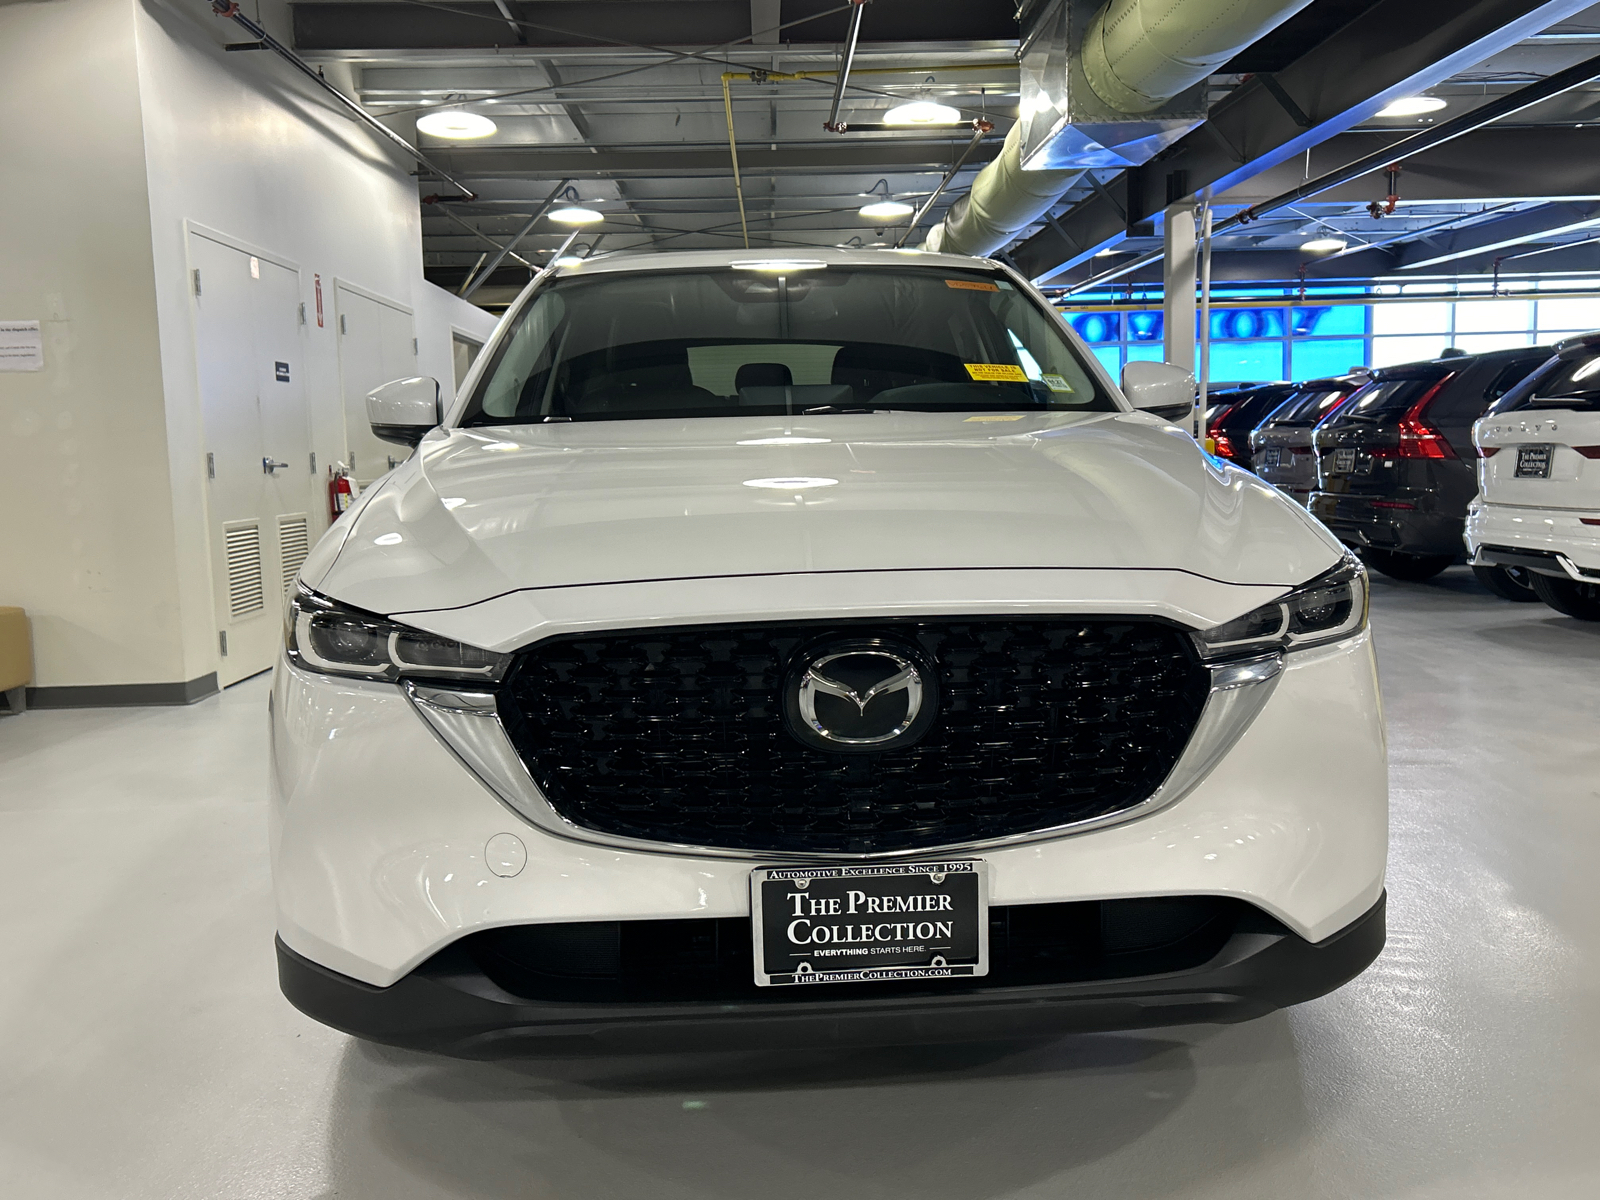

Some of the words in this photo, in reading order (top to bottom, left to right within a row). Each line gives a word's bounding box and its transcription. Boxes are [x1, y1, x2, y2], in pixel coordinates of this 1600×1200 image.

[769, 868, 838, 880] AUTOMOTIVE
[841, 866, 906, 877] EXCELLENCE
[908, 864, 940, 874] SINCE
[943, 862, 972, 872] 1995
[786, 892, 842, 917] THE
[846, 890, 954, 915] PREMIER
[786, 918, 954, 945] COLLECTION
[813, 947, 869, 957] EVERYTHING
[870, 946, 901, 955] STARTS
[902, 945, 927, 953] HERE.
